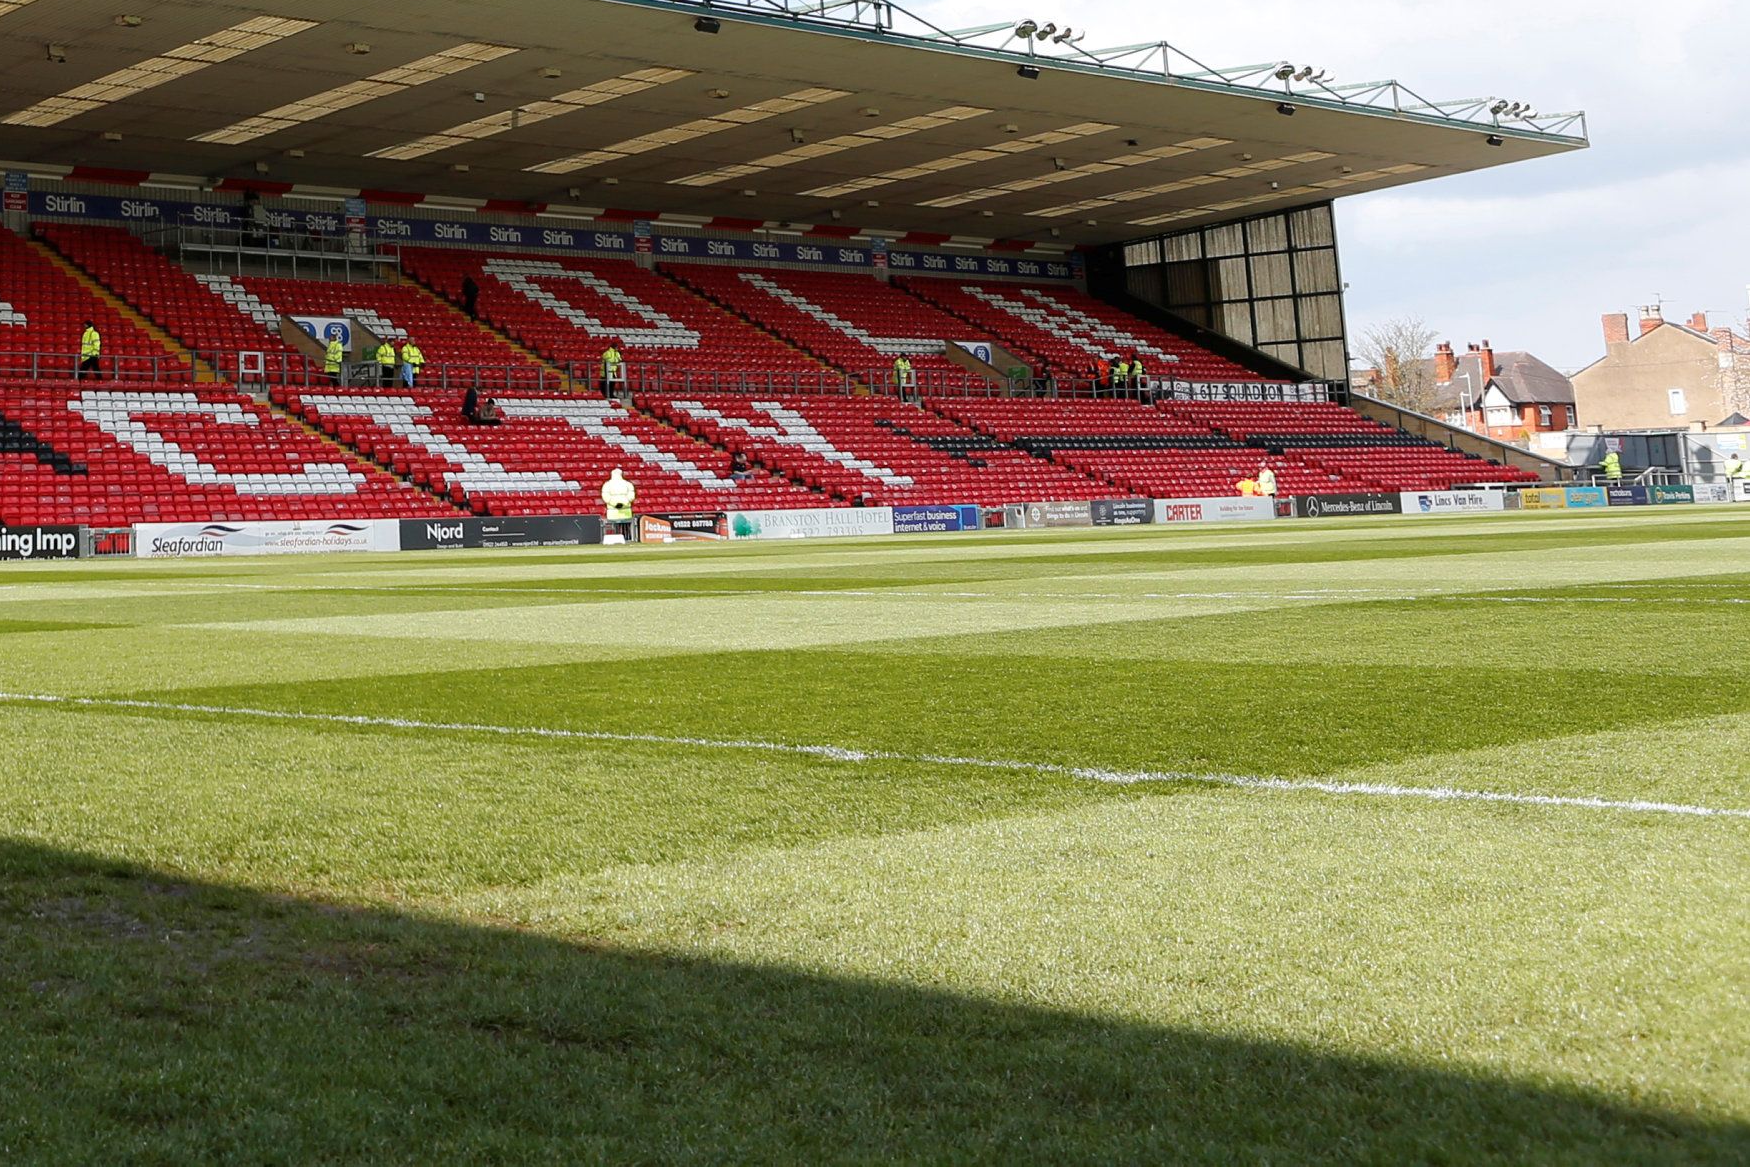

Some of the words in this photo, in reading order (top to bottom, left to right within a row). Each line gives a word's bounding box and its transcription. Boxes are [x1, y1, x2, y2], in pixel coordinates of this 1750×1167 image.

[45, 195, 86, 214] Stirlin
[121, 200, 160, 217] Stirlin
[193, 206, 231, 224] Stirlin
[377, 219, 411, 236] Stirlin
[434, 223, 467, 240] Stirlin
[489, 227, 522, 243] Stirlin
[543, 230, 574, 246] Stirlin
[594, 233, 625, 249] Stirlin
[660, 237, 689, 253] Stirlin
[707, 241, 735, 256] Stirlin
[752, 244, 780, 258] Stirlin
[796, 246, 823, 261] Stirlin
[838, 249, 865, 263] Stirlin
[1321, 501, 1364, 512] Mercedes-Benz
[1365, 500, 1371, 510] of
[1371, 500, 1393, 511] Lincoln
[1434, 495, 1452, 506] Lincs
[1453, 494, 1467, 505] Van
[1468, 493, 1483, 505] Hire
[764, 513, 820, 528] BRANSTON
[825, 511, 853, 525] HALL
[856, 510, 890, 523] HOTEL
[894, 511, 926, 523] Superfast
[926, 510, 957, 521] business
[1166, 504, 1203, 521] CARTER
[426, 523, 464, 542] Njord
[894, 522, 923, 532] internet
[922, 522, 928, 531] &
[928, 521, 947, 531] voice
[36, 527, 76, 556] Imp
[151, 537, 223, 556] Sleafordian
